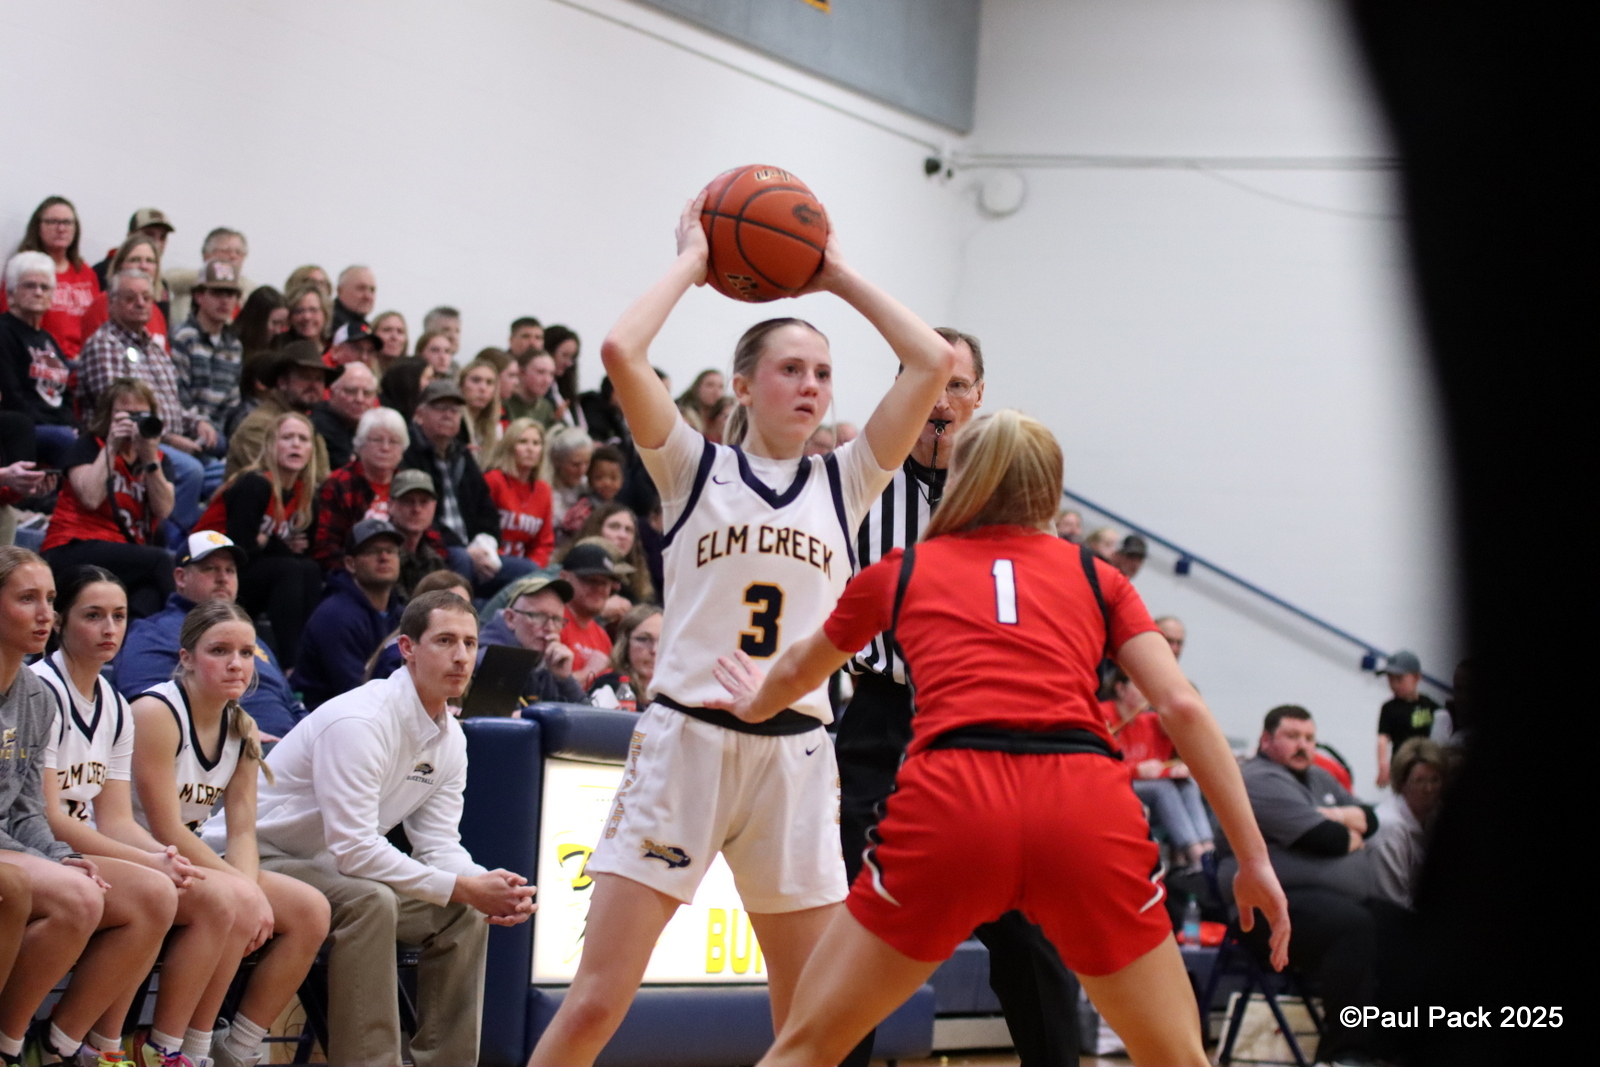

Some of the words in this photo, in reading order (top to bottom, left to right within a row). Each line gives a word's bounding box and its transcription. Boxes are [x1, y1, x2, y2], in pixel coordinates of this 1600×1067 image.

[697, 524, 750, 569] ELM
[758, 525, 834, 581] CREEK
[737, 581, 786, 660] 3
[991, 558, 1020, 625] 1
